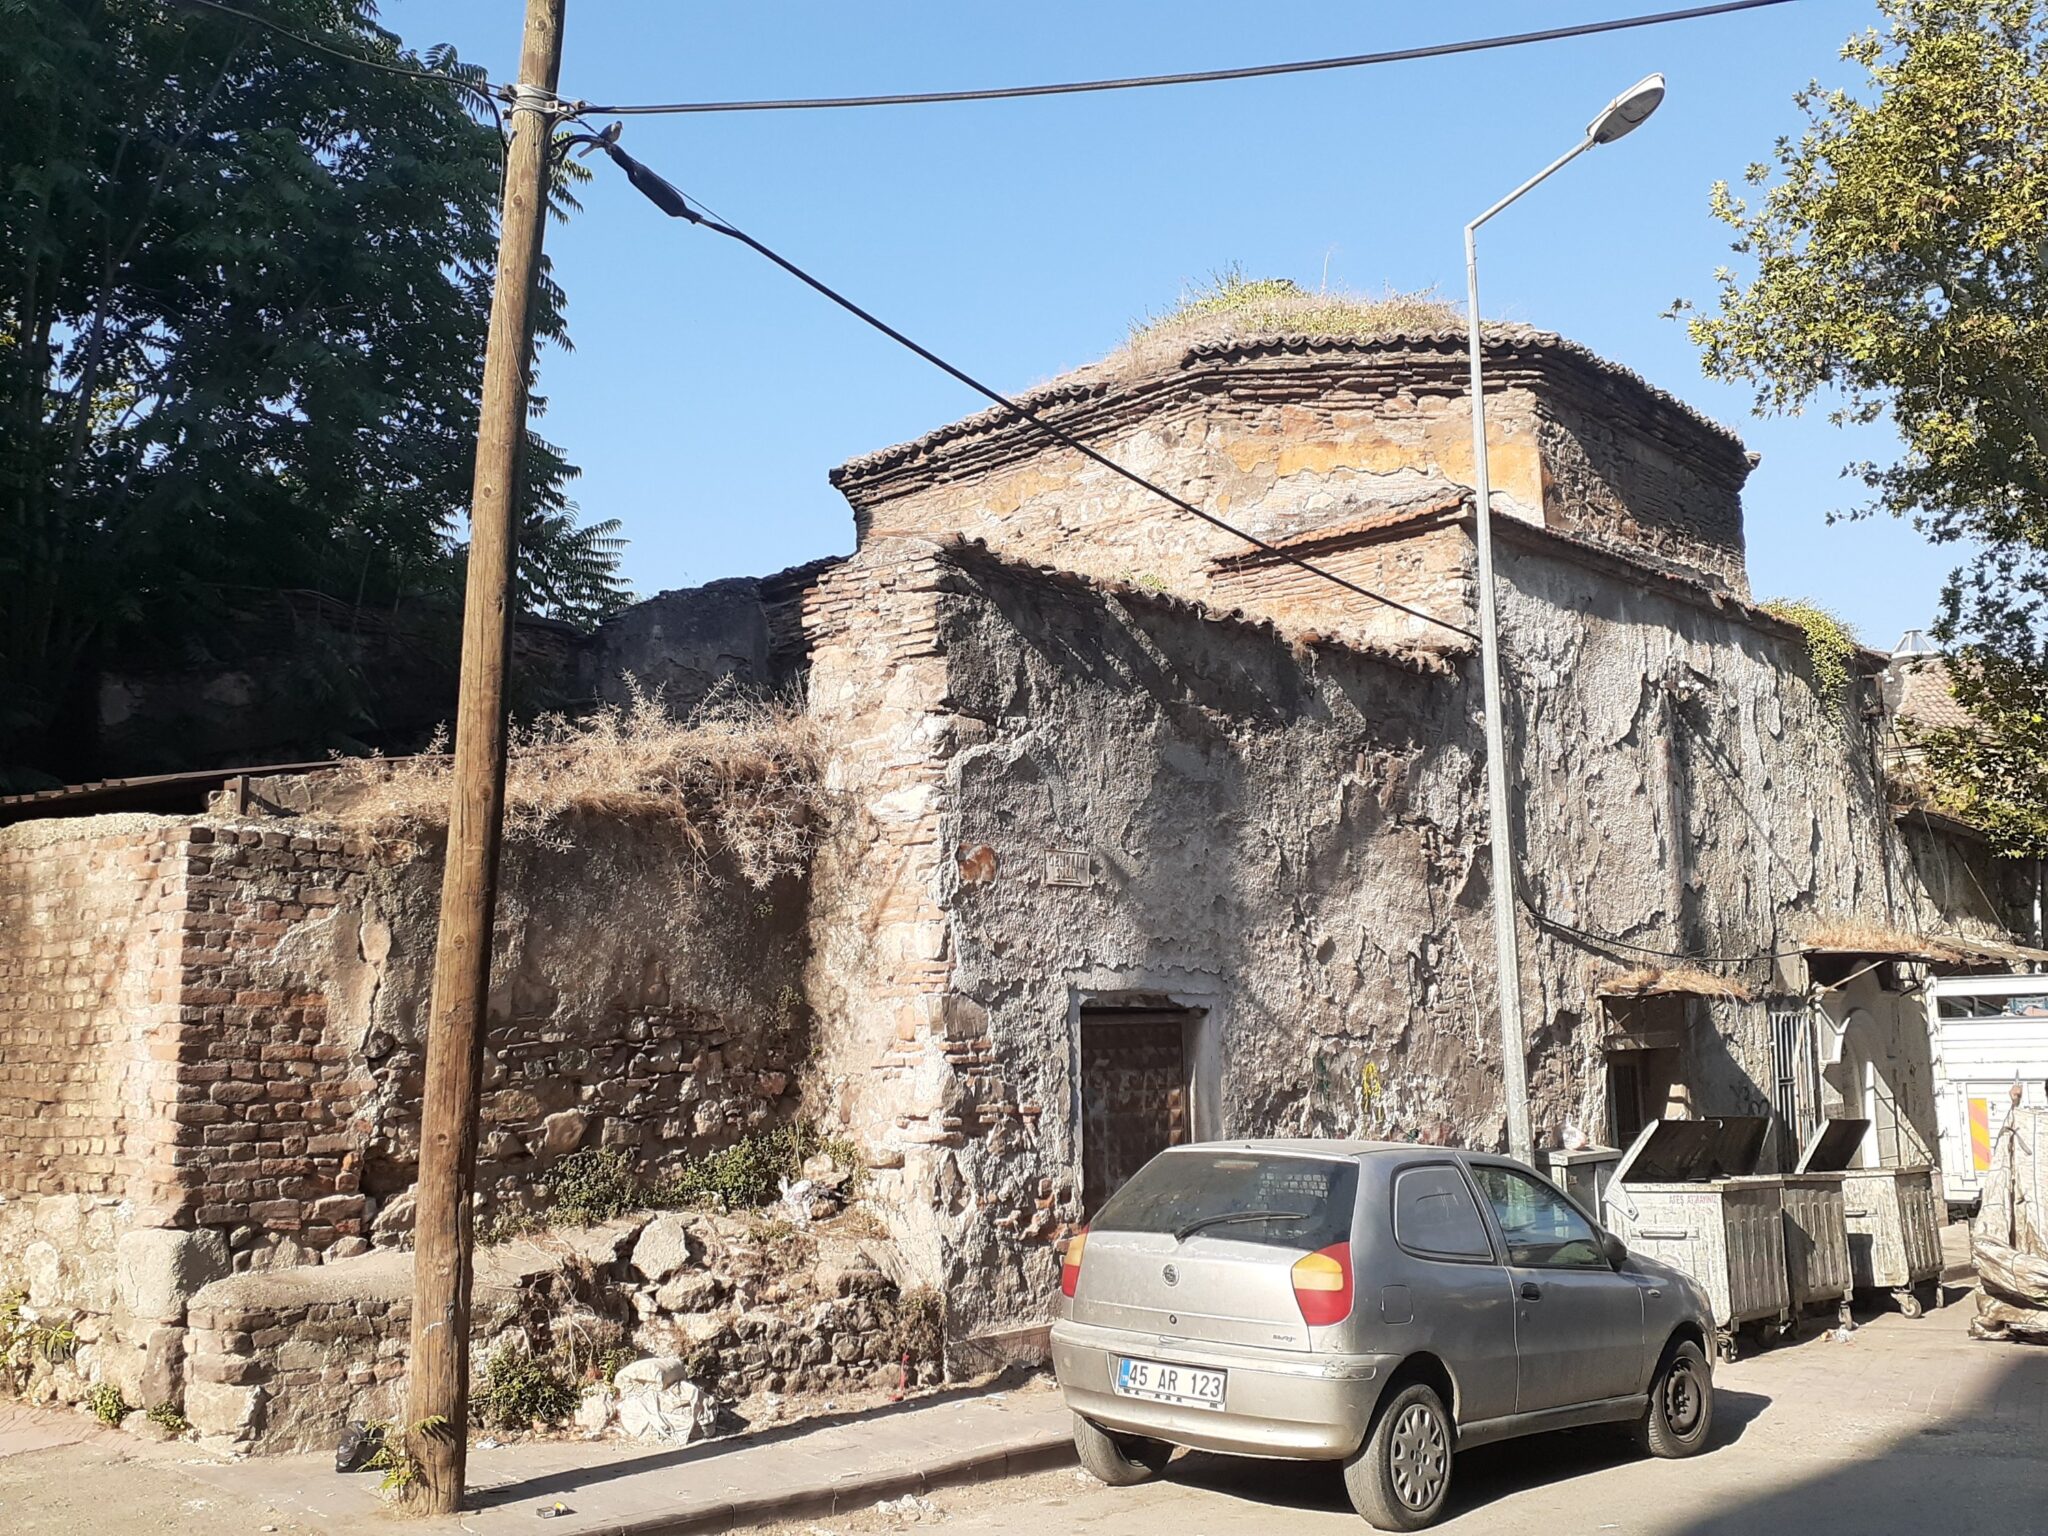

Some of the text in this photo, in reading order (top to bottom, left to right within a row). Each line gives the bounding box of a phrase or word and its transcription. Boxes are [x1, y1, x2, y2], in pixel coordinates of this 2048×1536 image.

[1129, 1364, 1149, 1386] 45
[1157, 1368, 1178, 1391] AR
[1191, 1373, 1221, 1398] 123
